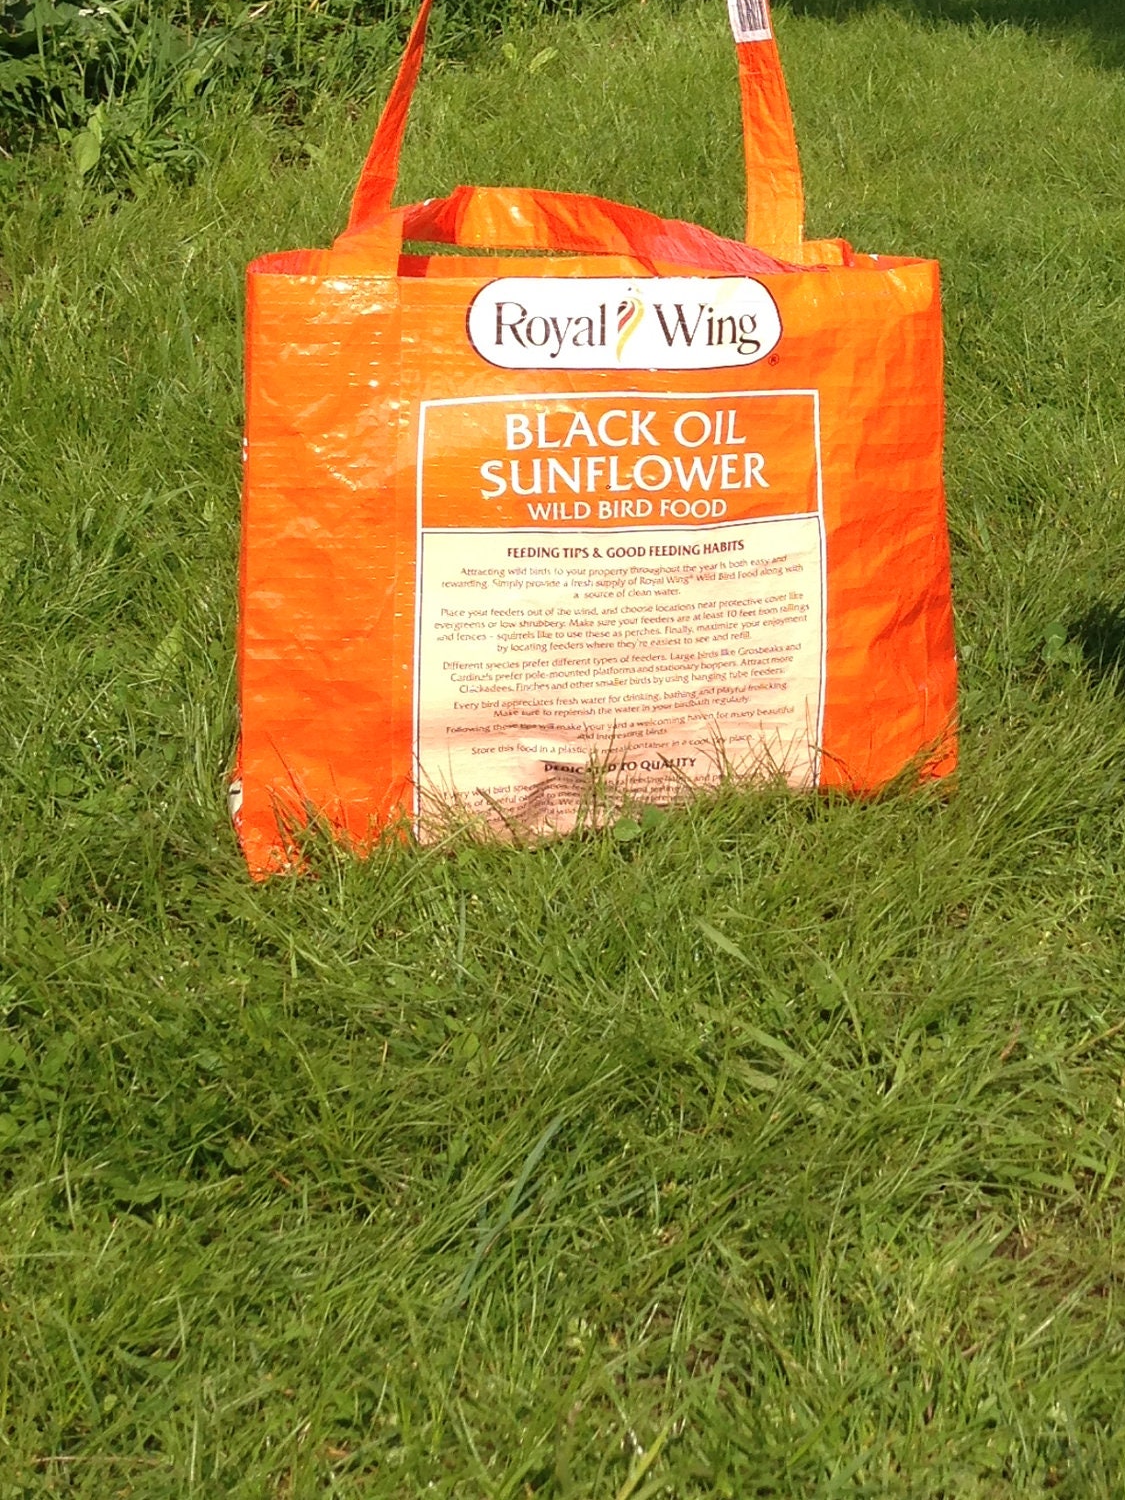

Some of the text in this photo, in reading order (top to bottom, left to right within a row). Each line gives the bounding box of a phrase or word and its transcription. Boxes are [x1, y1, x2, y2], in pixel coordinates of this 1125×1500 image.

[493, 301, 606, 358] Royal
[654, 303, 760, 355] Wing
[505, 410, 746, 451] BLACK OIL
[480, 453, 770, 500] SUNFLOWER
[528, 499, 728, 522] WILD BIRD FOOD
[507, 540, 744, 558] FEEDING TIPS & GOOD FEEDING HABITS
[589, 568, 628, 577] property
[491, 608, 524, 616] feeders
[656, 603, 695, 612] locations
[550, 642, 584, 650] feeders
